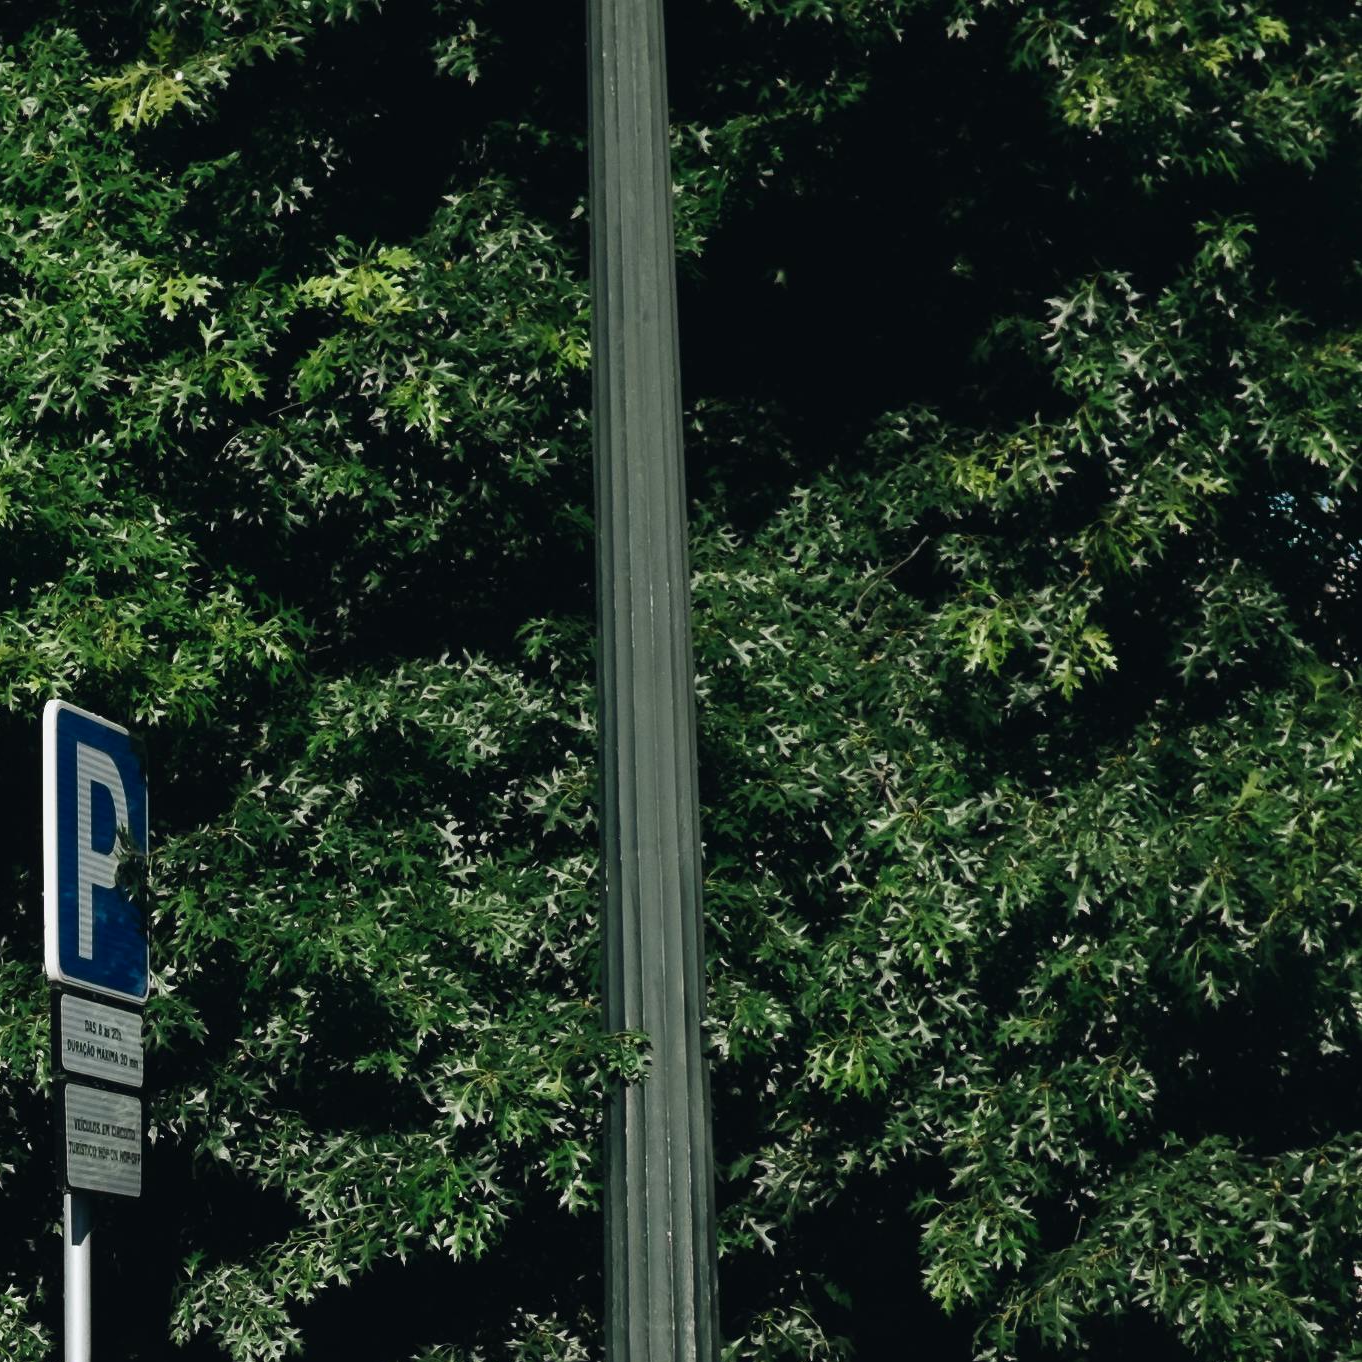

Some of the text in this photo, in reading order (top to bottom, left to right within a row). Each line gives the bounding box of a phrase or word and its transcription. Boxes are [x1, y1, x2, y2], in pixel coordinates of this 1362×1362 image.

[77, 741, 129, 960] P
[84, 1020, 96, 1034] DAS
[67, 1039, 95, 1058] DURAÇÃO
